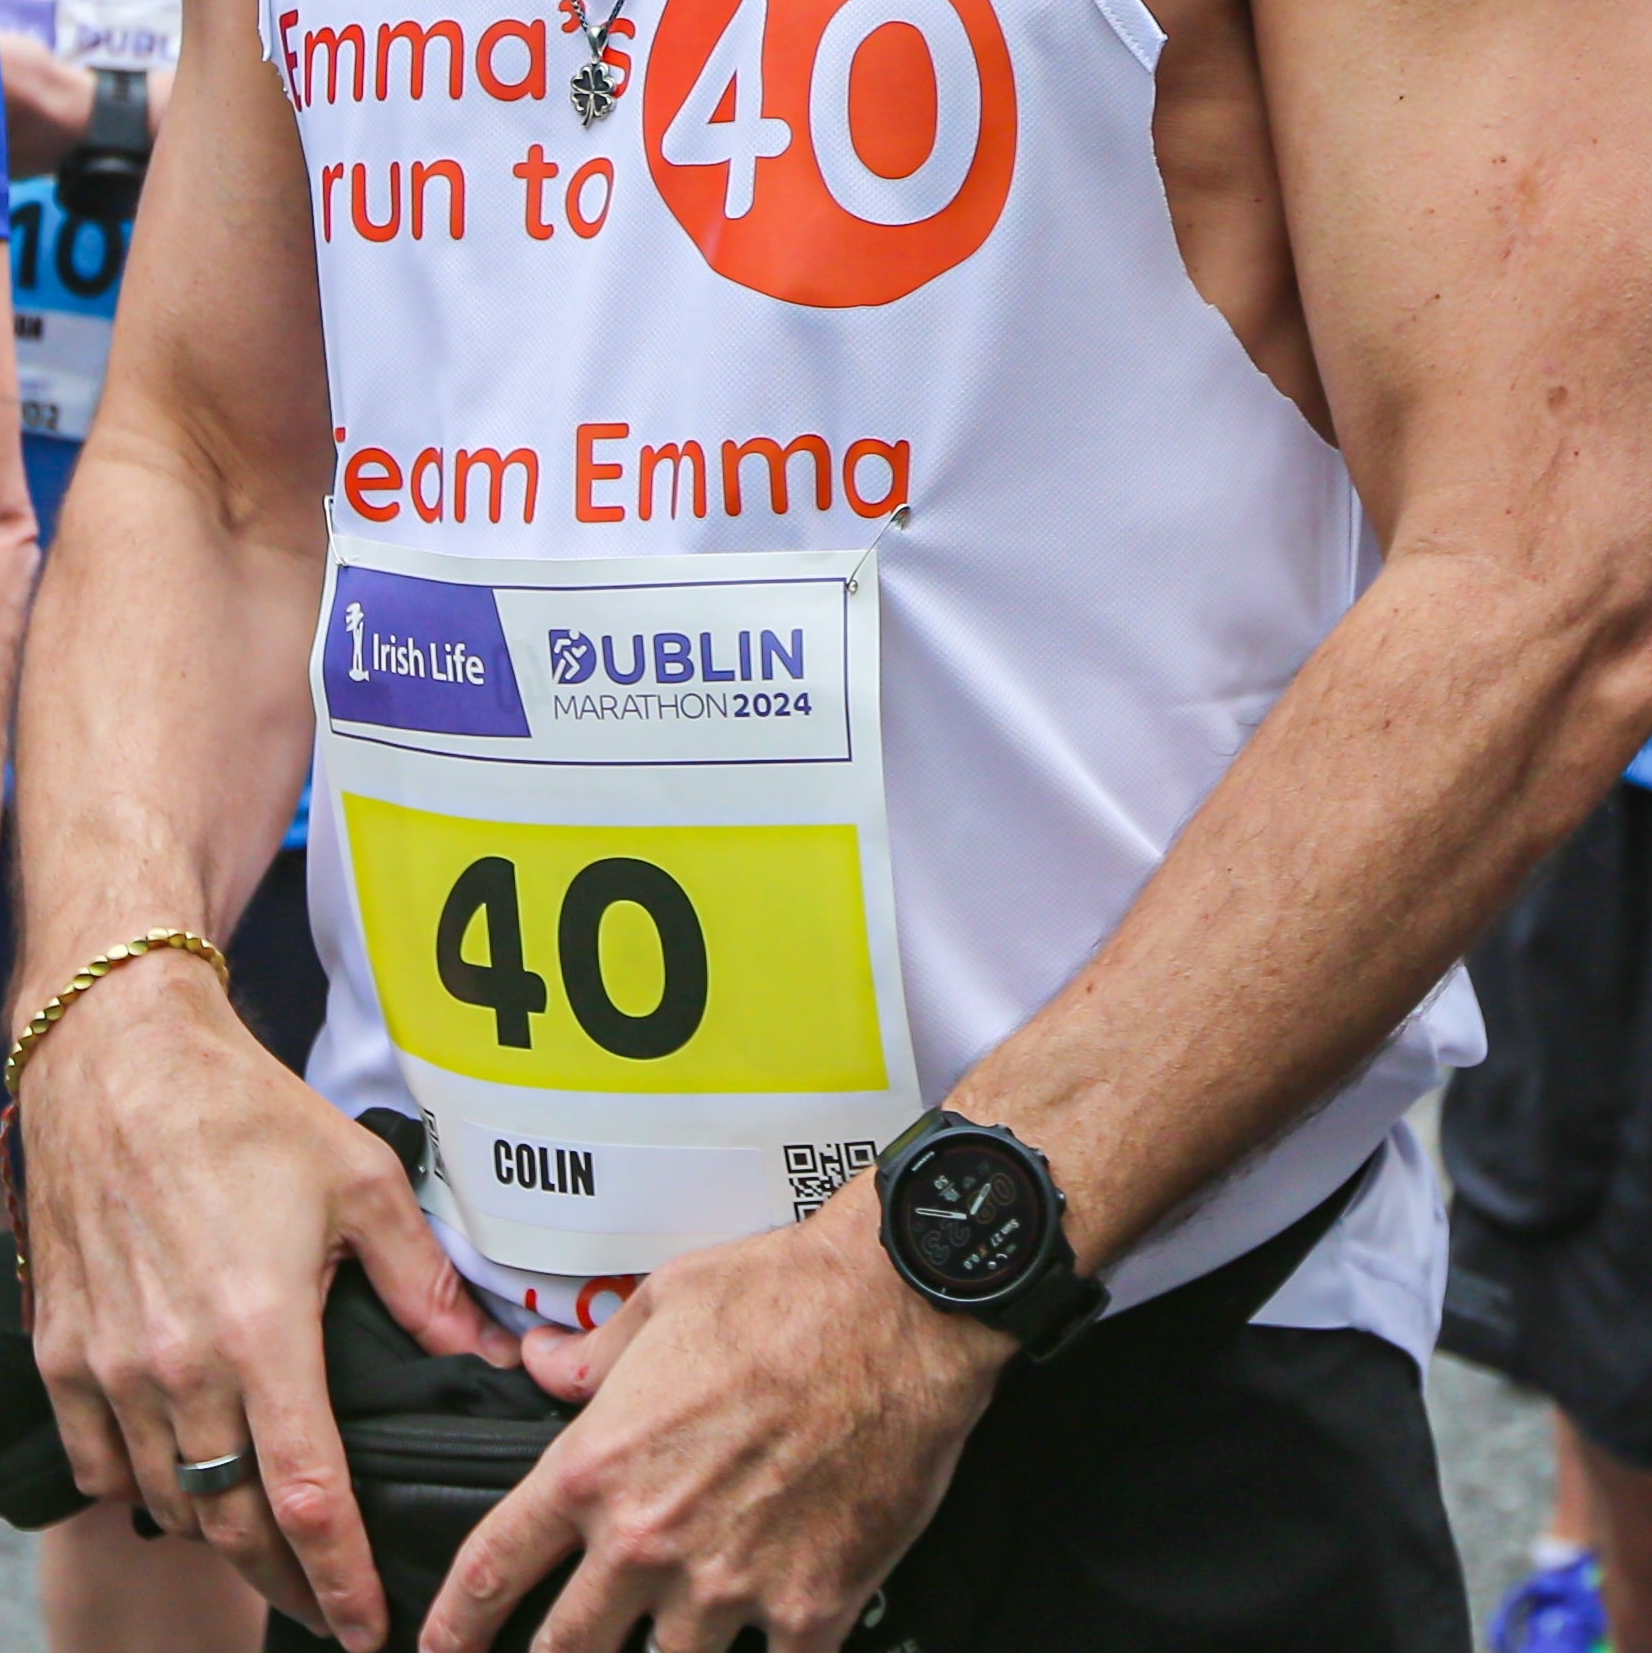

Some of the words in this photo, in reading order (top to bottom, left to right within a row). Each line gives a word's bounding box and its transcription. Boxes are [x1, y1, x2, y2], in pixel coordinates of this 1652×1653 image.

[322, 159, 466, 243] run
[513, 143, 615, 241] to
[335, 426, 539, 524] eam
[575, 419, 911, 524] Emma
[372, 631, 430, 681] Irish
[433, 638, 485, 686] Life
[548, 629, 804, 685] DUBLIN
[553, 692, 729, 721] MARATHON
[733, 692, 813, 719] 2024
[436, 855, 709, 1061] 40
[493, 1138, 596, 1197] COLIN
